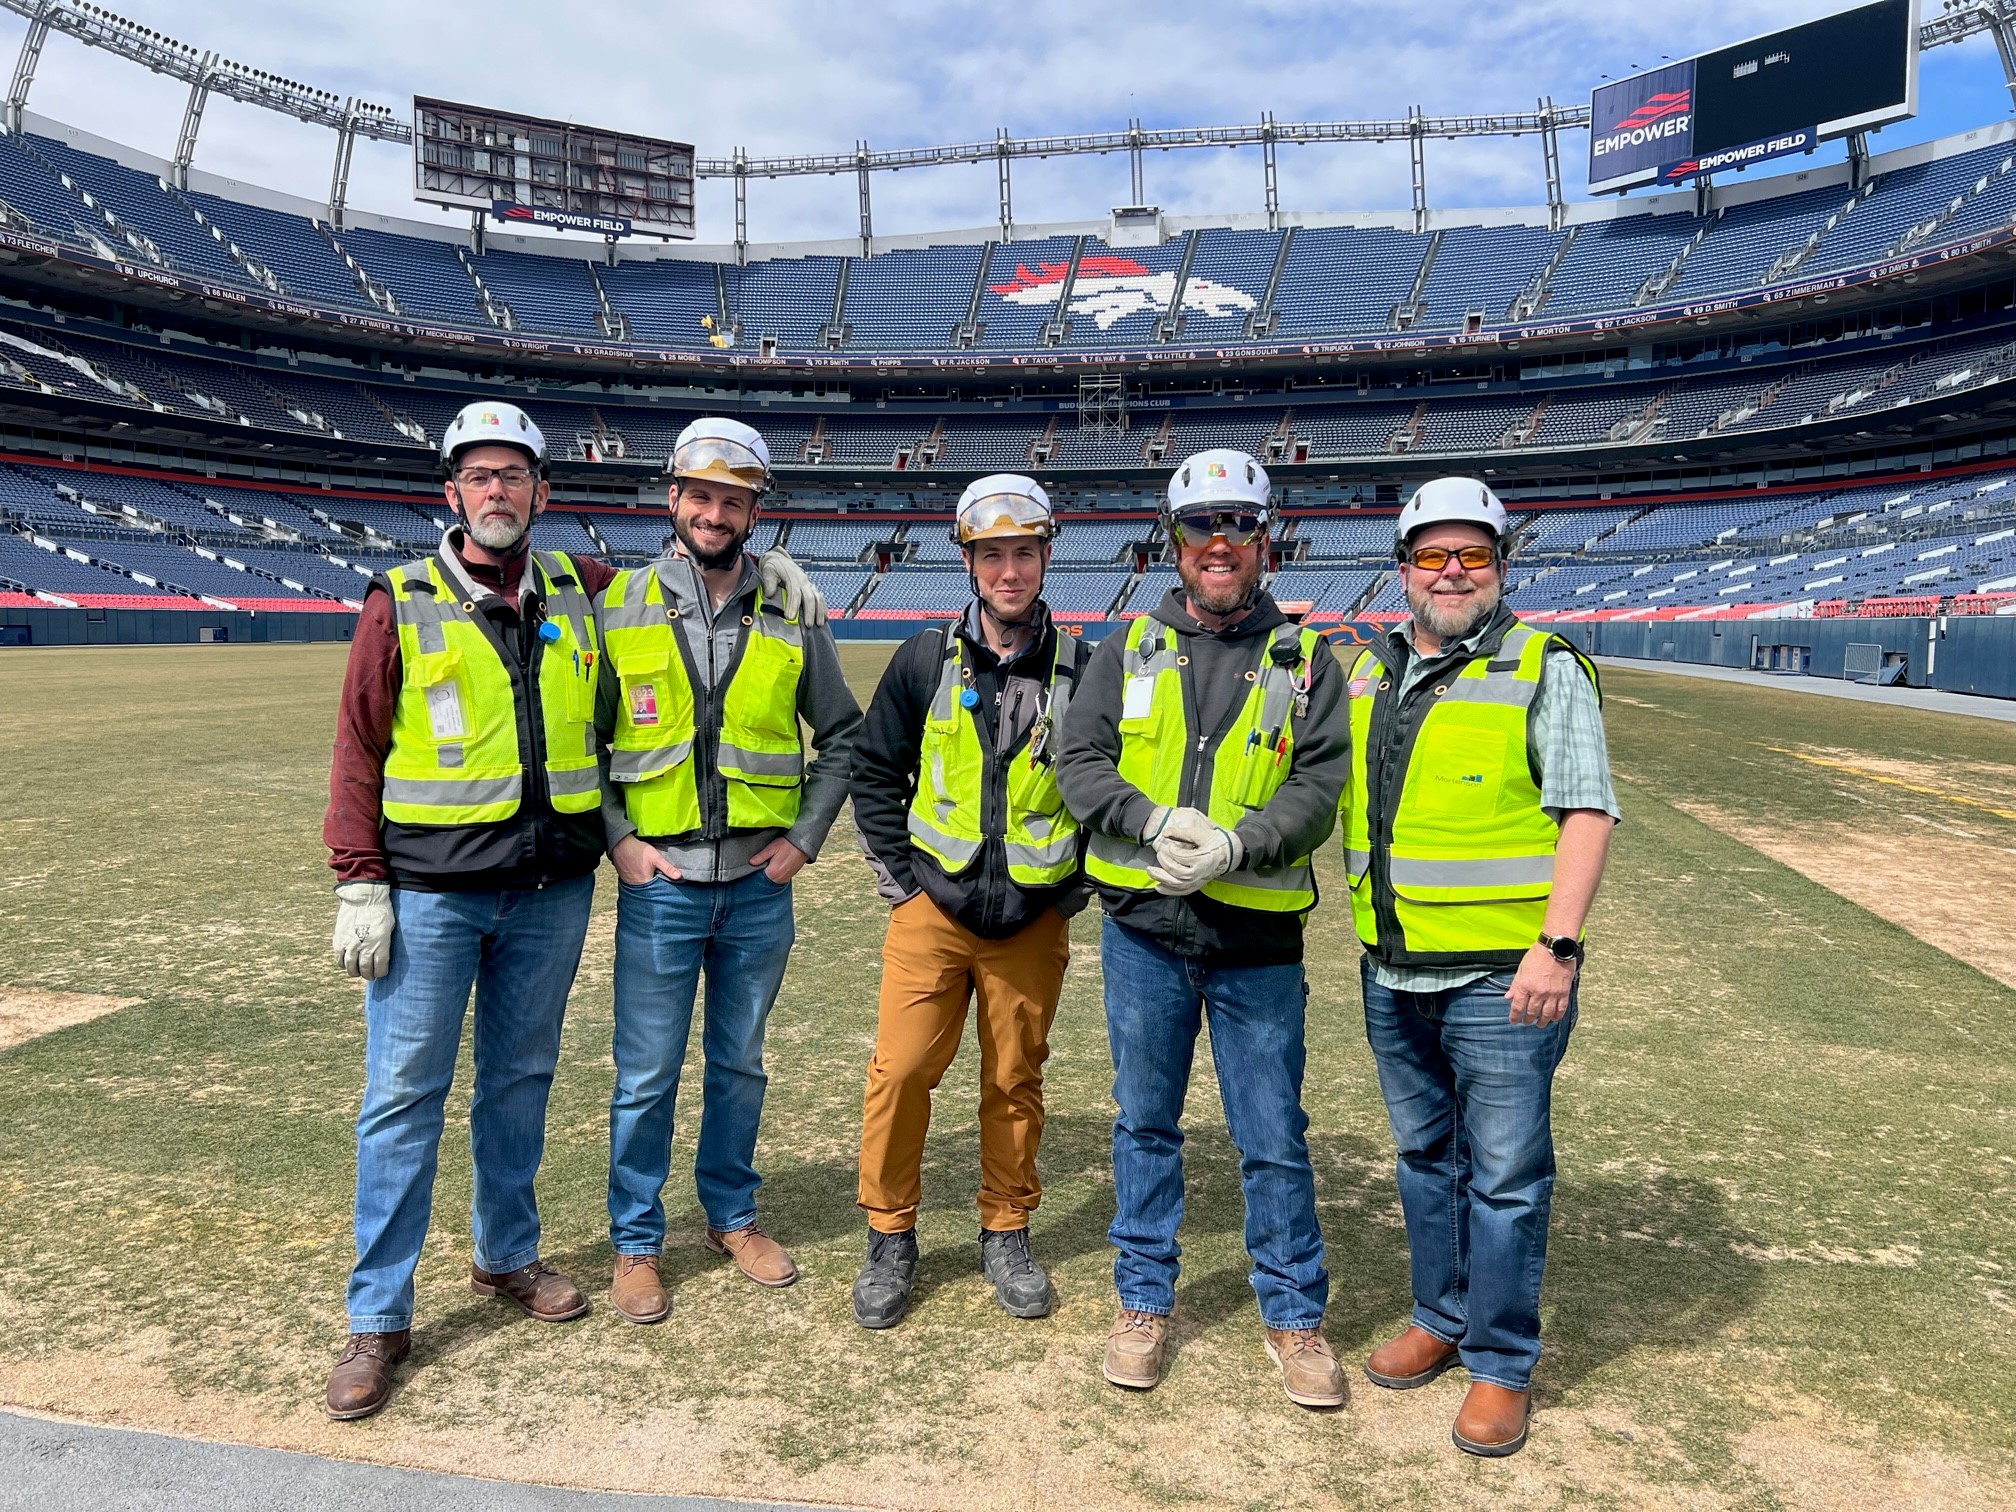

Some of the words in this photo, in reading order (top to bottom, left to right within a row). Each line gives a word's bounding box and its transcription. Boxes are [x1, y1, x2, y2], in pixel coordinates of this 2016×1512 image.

[1594, 118, 1688, 156] EMPOWER
[1699, 143, 1765, 170] EMPOWER
[1767, 133, 1806, 154] FIELD
[533, 210, 592, 228] EMPOWER
[593, 220, 624, 232] FIELD
[7, 235, 17, 246] 73
[17, 238, 56, 255] FLETCHER
[1950, 248, 1959, 257] 80
[1961, 245, 1969, 254] R.
[1970, 238, 1992, 252] SMITH
[1878, 267, 1888, 276] 30
[1889, 262, 1909, 274] DAVIS
[124, 266, 134, 275] 80
[137, 270, 179, 287] UPCHURCH
[212, 288, 221, 297] 66
[222, 290, 246, 302] NALEN
[1774, 291, 1784, 300] 65
[1786, 280, 1835, 297] ZIMMERMAN
[277, 303, 285, 311] 84
[286, 304, 311, 317] SHARPE
[1693, 306, 1703, 314] 49
[1713, 301, 1738, 311] SMITH
[349, 317, 358, 325] 27
[359, 319, 391, 331] ATWATER
[1622, 314, 1657, 326] JACKSON
[416, 328, 425, 336] 77
[426, 330, 475, 342] MECKLENBURG
[1530, 329, 1535, 337] 7
[1536, 326, 1571, 337] MORTON
[1383, 341, 1391, 349] 12
[1392, 340, 1425, 348] JOHNSON
[1467, 334, 1496, 343] TURNER
[511, 340, 520, 348] 20
[521, 342, 550, 351] WRIGHT
[1320, 344, 1354, 353] TRIPUCKA
[594, 348, 634, 358] GRADISHAR
[668, 353, 676, 361] 25
[677, 354, 701, 362] MOSES
[1163, 352, 1187, 360] LITTLE
[1235, 348, 1279, 357] GONSOULIN
[749, 358, 787, 366] THOMPSON
[956, 358, 990, 366] JACKSON
[1031, 356, 1058, 364] TAYLOR
[1094, 355, 1117, 363] ELWAY
[630, 688, 654, 698] 2023
[1435, 775, 1482, 788] Mortenson
